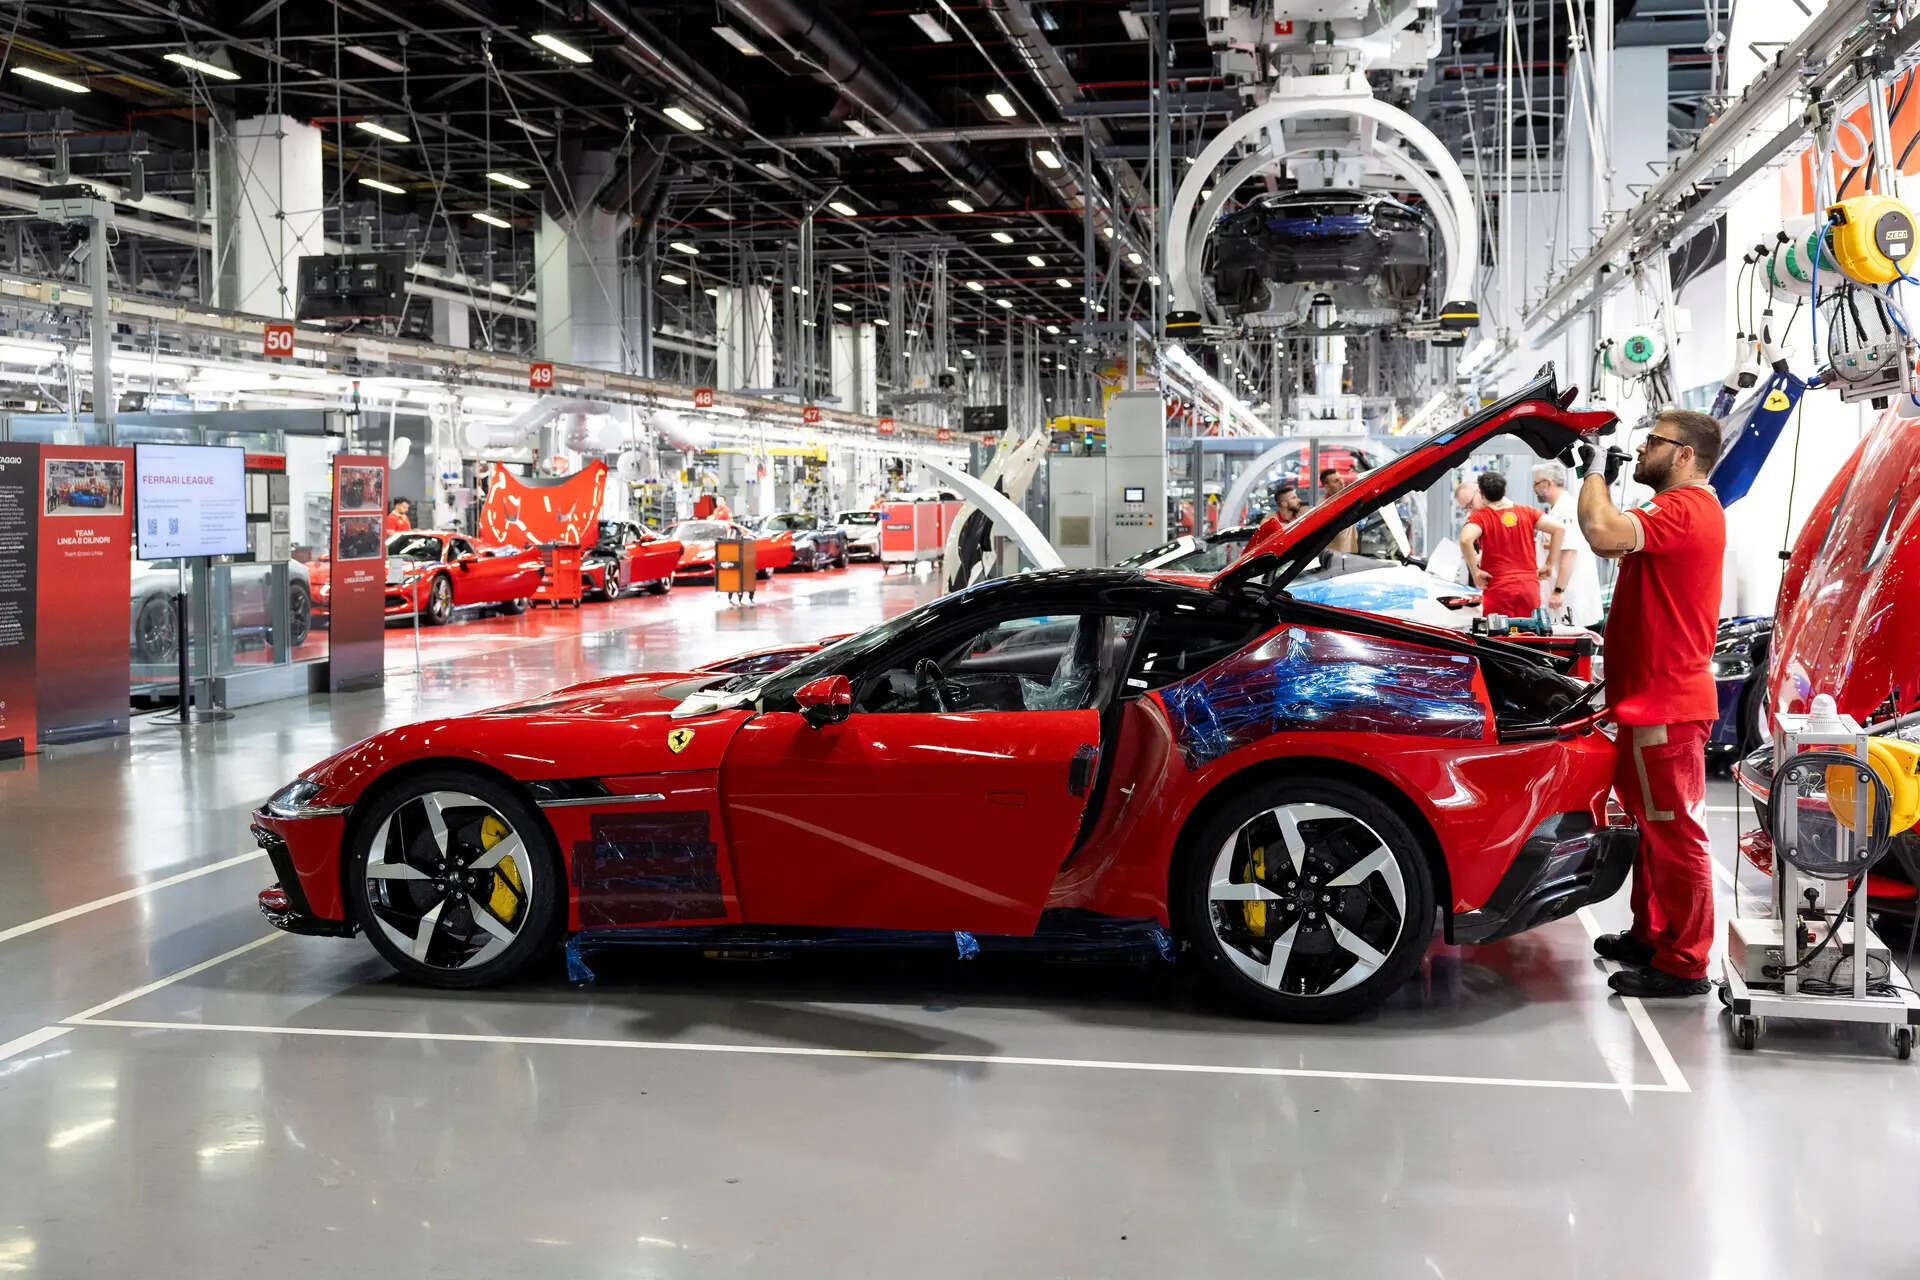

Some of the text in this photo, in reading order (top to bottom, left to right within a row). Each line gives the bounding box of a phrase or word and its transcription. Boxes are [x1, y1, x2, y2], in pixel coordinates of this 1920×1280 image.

[1887, 231, 1907, 239] ZECA
[267, 331, 292, 350] 50
[532, 368, 552, 383] 49
[696, 392, 711, 405] 48
[804, 410, 818, 420] 47
[142, 475, 214, 485] FERRARI LEAGUE
[75, 529, 94, 537] TEAM
[57, 537, 77, 545] LINEA
[82, 536, 111, 544] CILINDRI
